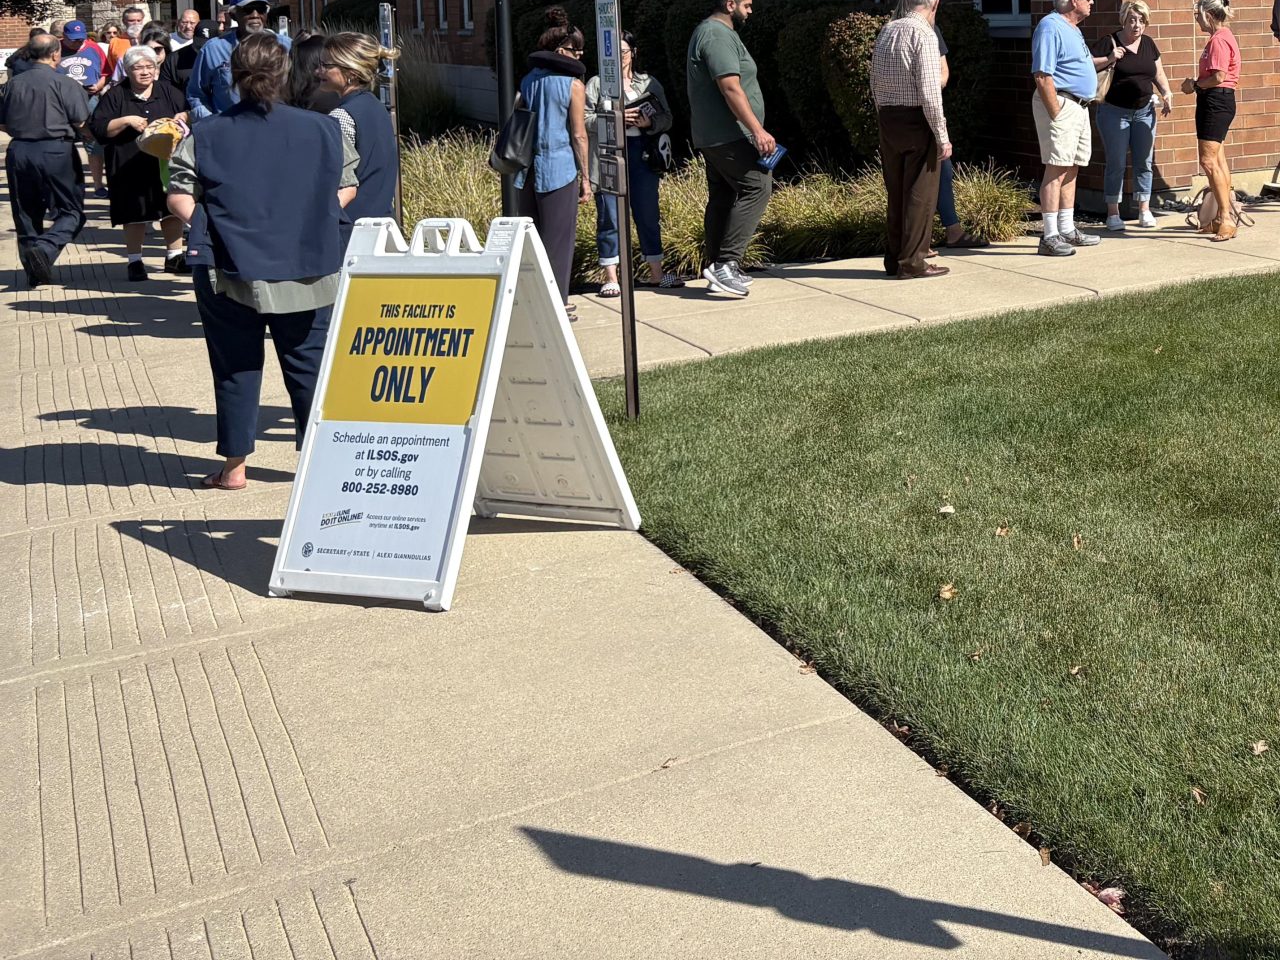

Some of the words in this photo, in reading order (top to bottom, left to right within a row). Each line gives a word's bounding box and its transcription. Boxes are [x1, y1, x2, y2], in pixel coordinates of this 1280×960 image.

[380, 303, 401, 318] THIS
[402, 304, 444, 319] FACILITY
[445, 304, 456, 319] IS
[349, 327, 474, 357] APPOINTMENT
[370, 365, 435, 403] ONLY
[332, 431, 375, 444] Schedule
[376, 435, 389, 445] an
[390, 434, 450, 447] appointment
[355, 451, 365, 460] at
[366, 449, 419, 464] ILSOS.gov
[354, 467, 365, 477] or
[366, 465, 379, 479] by
[380, 467, 412, 481] calling
[341, 481, 419, 496] 800-252-8980
[316, 547, 347, 556] SECRETARY
